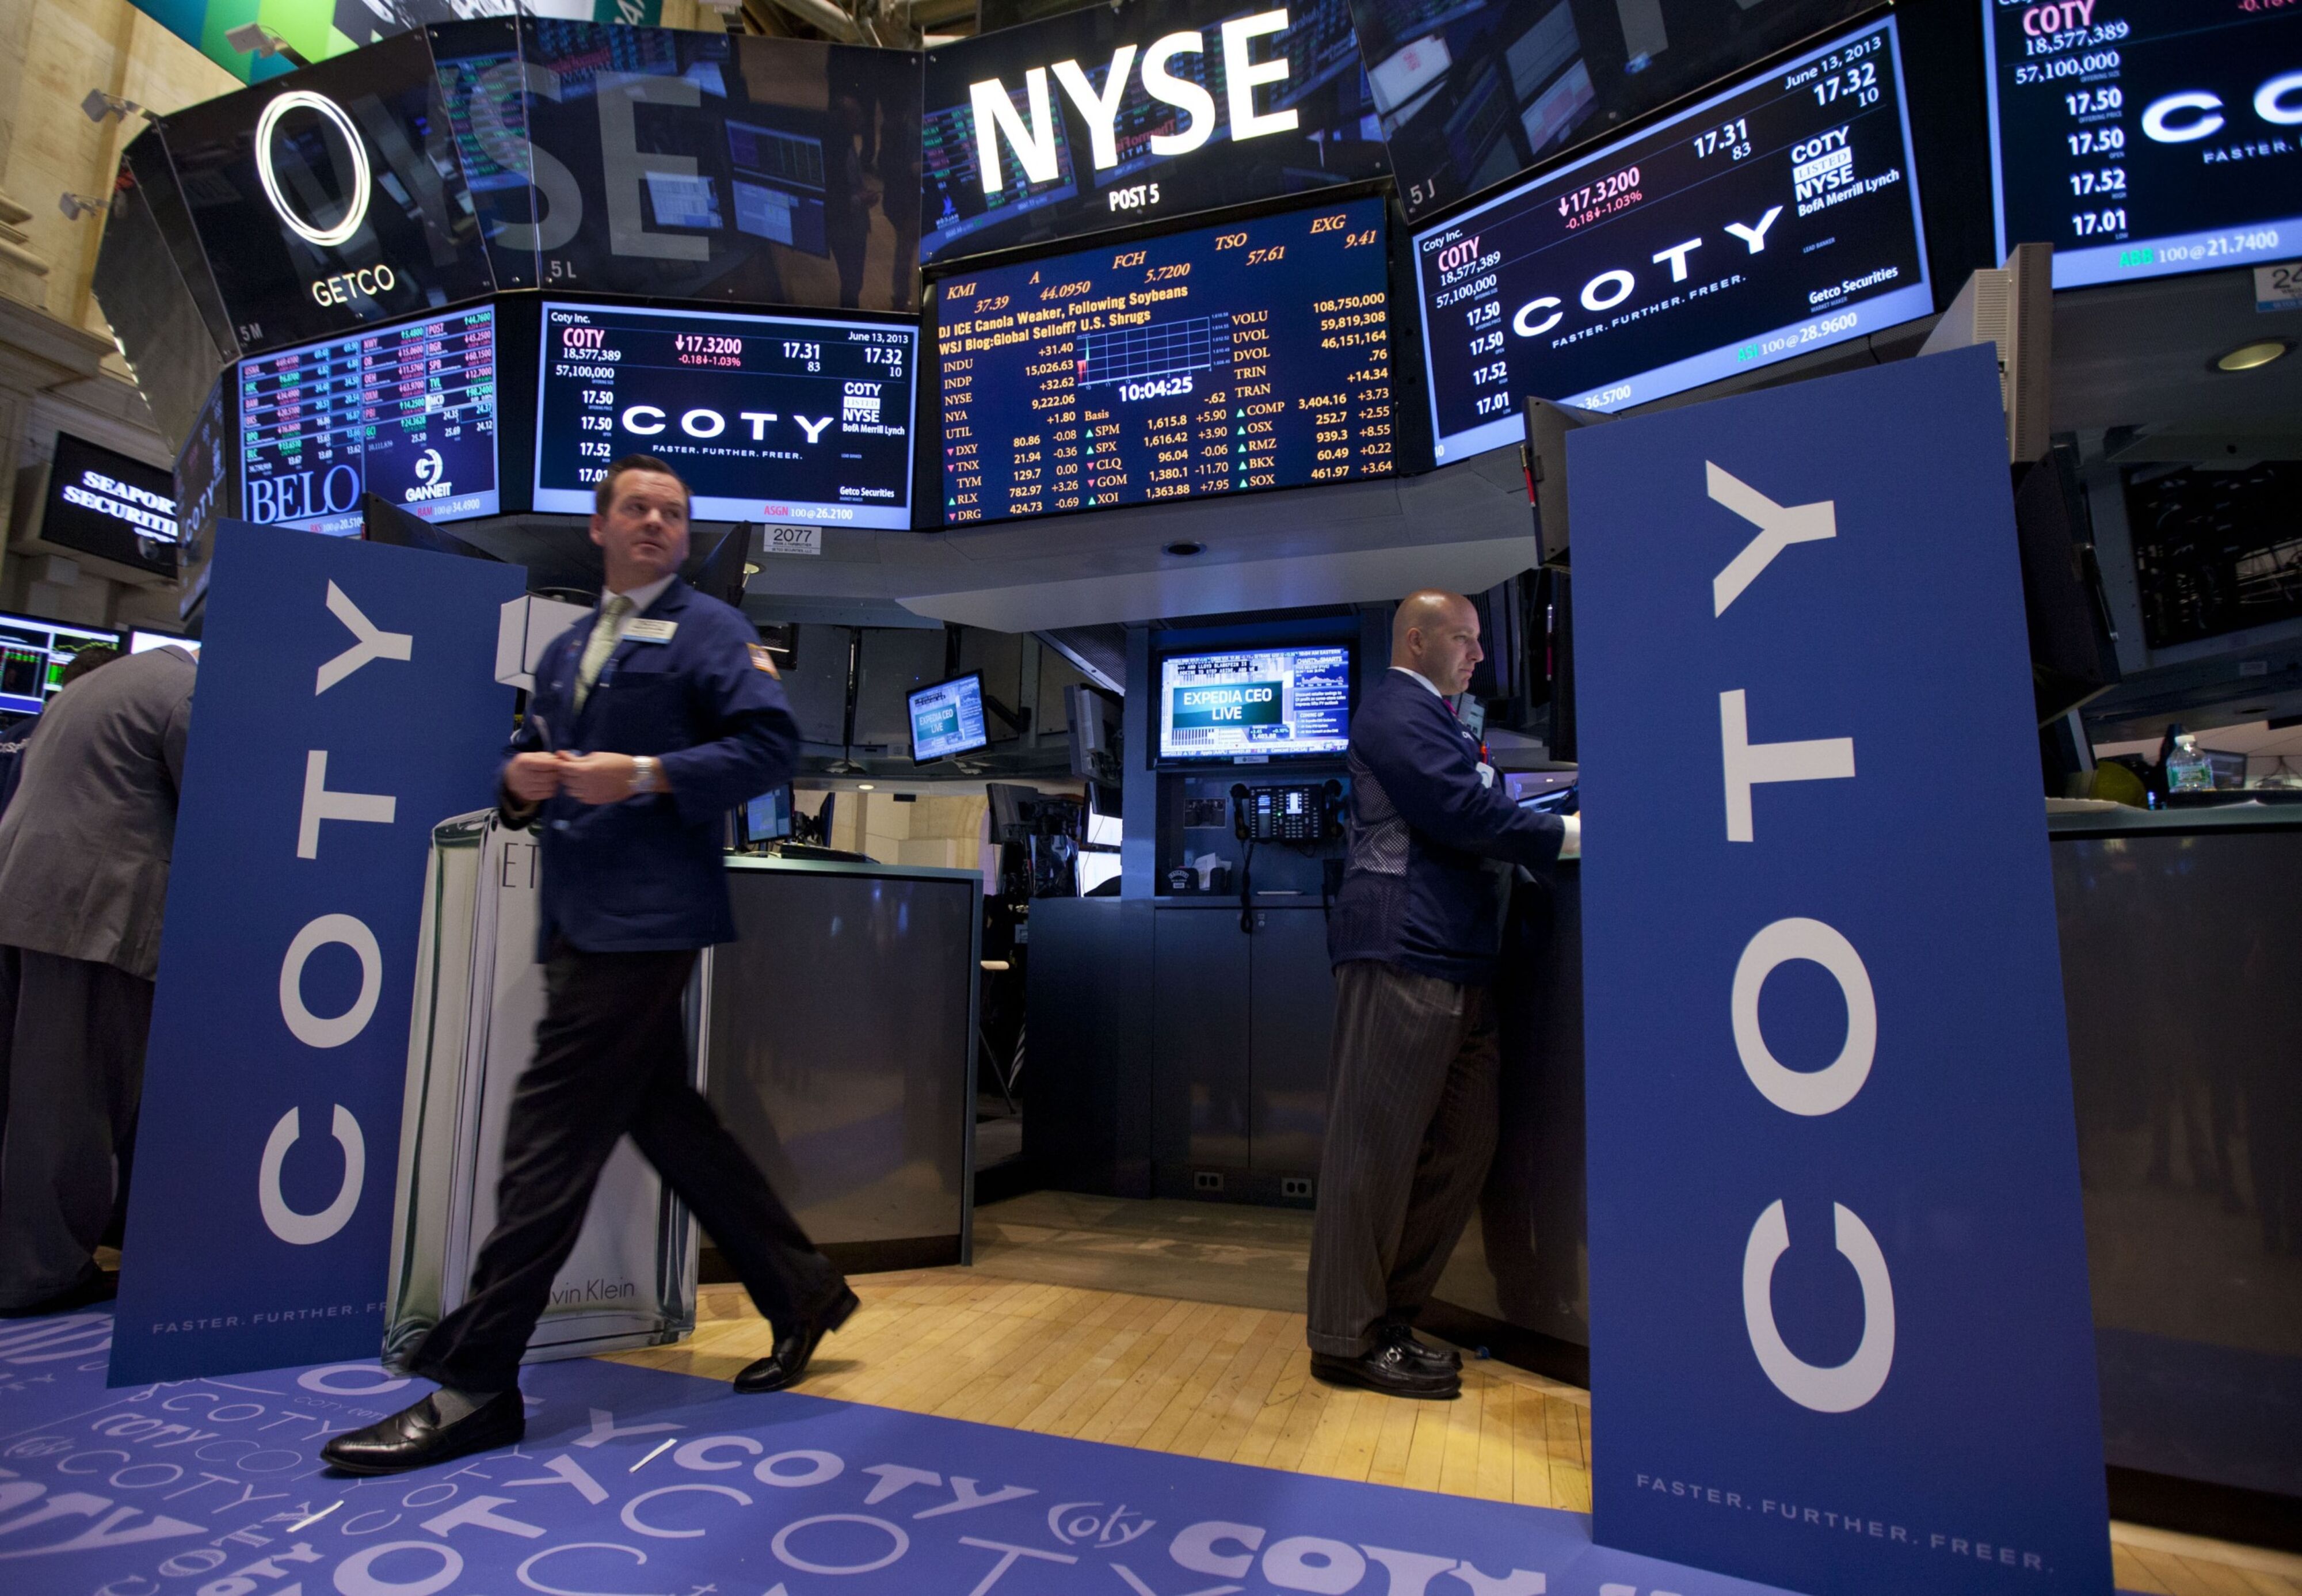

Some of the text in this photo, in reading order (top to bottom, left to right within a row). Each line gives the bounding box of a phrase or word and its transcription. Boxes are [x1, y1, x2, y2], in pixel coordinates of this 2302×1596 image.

[2023, 0, 2096, 36] COTY
[2026, 19, 2129, 55] 18,577,389
[1785, 36, 1882, 90] June 13, 2013
[2016, 49, 2121, 84] 57,100,000
[969, 8, 1299, 194] NYSE
[2065, 86, 2122, 115] 17.50
[1571, 63, 1877, 213] 17.3200 17.31 17.32
[1791, 126, 1849, 164] COTY
[2203, 141, 2294, 164] FASTER.
[1797, 151, 1848, 180] LISTED
[1411, 178, 1436, 205] 5 J
[1794, 163, 1854, 202] NYSE
[2070, 167, 2126, 196] 17.52
[1109, 183, 1160, 212] POST 5
[2072, 210, 2126, 236] 17.01
[1423, 230, 1462, 252] Coty Inc.
[1439, 237, 1480, 272] COTY
[1803, 237, 1836, 253] LEAD BANKER
[551, 261, 576, 279] 5 L
[947, 215, 1346, 299] KMI A FCH TSO EXG
[1440, 251, 1501, 287] 18,577,389
[1513, 205, 1783, 337] COTY
[2119, 247, 2154, 268] ABB
[312, 264, 395, 307] GETCO
[974, 230, 1377, 314] 37.39 44.0950 5.7200 57.61 9.41
[1809, 266, 1899, 304] Getco Securities
[1436, 274, 1497, 308] 57,100,000
[551, 312, 590, 324] Coty Inc.
[939, 286, 1188, 338] DJ ICE Canola Weaker, Following Soybeans
[1232, 292, 1385, 325] VOLU 108,750,000
[1553, 275, 1746, 349] FASTER. FURTHER. FREER.
[848, 332, 908, 344] June 13, 2013
[939, 340, 962, 355] WSJ
[1033, 321, 1076, 340] Selloff?
[1081, 317, 1105, 332] U.S.
[1109, 311, 1151, 326] Shrugs
[1233, 311, 1386, 344] UVOL 59,819,308
[563, 327, 902, 365] COTY 17.3200 17.31 17.32
[563, 347, 621, 361] 18,577,389
[944, 342, 1073, 373] INDU +31.40
[1234, 330, 1387, 362] DVOL 46,151,164
[1737, 343, 1759, 363] ASI
[556, 364, 614, 379] 57,100,000
[944, 360, 1074, 389] INDP 15,026.63
[1235, 368, 1388, 398] TRAN +14.34
[582, 390, 613, 405] 17.50
[844, 382, 882, 396] COTY
[945, 377, 1074, 406] NYSE +32.62
[1119, 376, 1193, 402] 10:04:25
[1247, 388, 1389, 416] COMP 3,404.16 +3.73
[622, 405, 834, 443] COTY
[843, 408, 880, 423] NYSE
[843, 422, 905, 436] BofA Merrill Lynch
[1084, 409, 1109, 421] Basis
[1095, 409, 1226, 436] SPM 1,615.8 +5.90
[580, 443, 611, 456] 17.52
[653, 445, 803, 459] FASTER. FURTHER. FREER.
[1250, 461, 1392, 486] SOX 461.97 +3.64
[82, 471, 177, 516] SEAPOR
[248, 464, 360, 524] BELO
[405, 482, 452, 502] GANNETT
[840, 486, 894, 498] Getco Securities
[764, 505, 788, 516] ASGN
[773, 528, 812, 542] 2077
[1184, 688, 1272, 705] EXPEDIA CEO
[1212, 706, 1242, 720] LIVE
[259, 578, 413, 1245] COTY
[1706, 459, 1896, 1413] COTY
[547, 1277, 635, 1306] vin Klein
[153, 1315, 245, 1335] FASTER.
[254, 1304, 360, 1324] FURTHER.
[58, 1450, 290, 1514] COTY
[673, 1435, 1039, 1520] COTY
[1047, 1501, 1157, 1548] Coty
[1637, 1473, 2054, 1574] FASTER. FURTHER. FREER.
